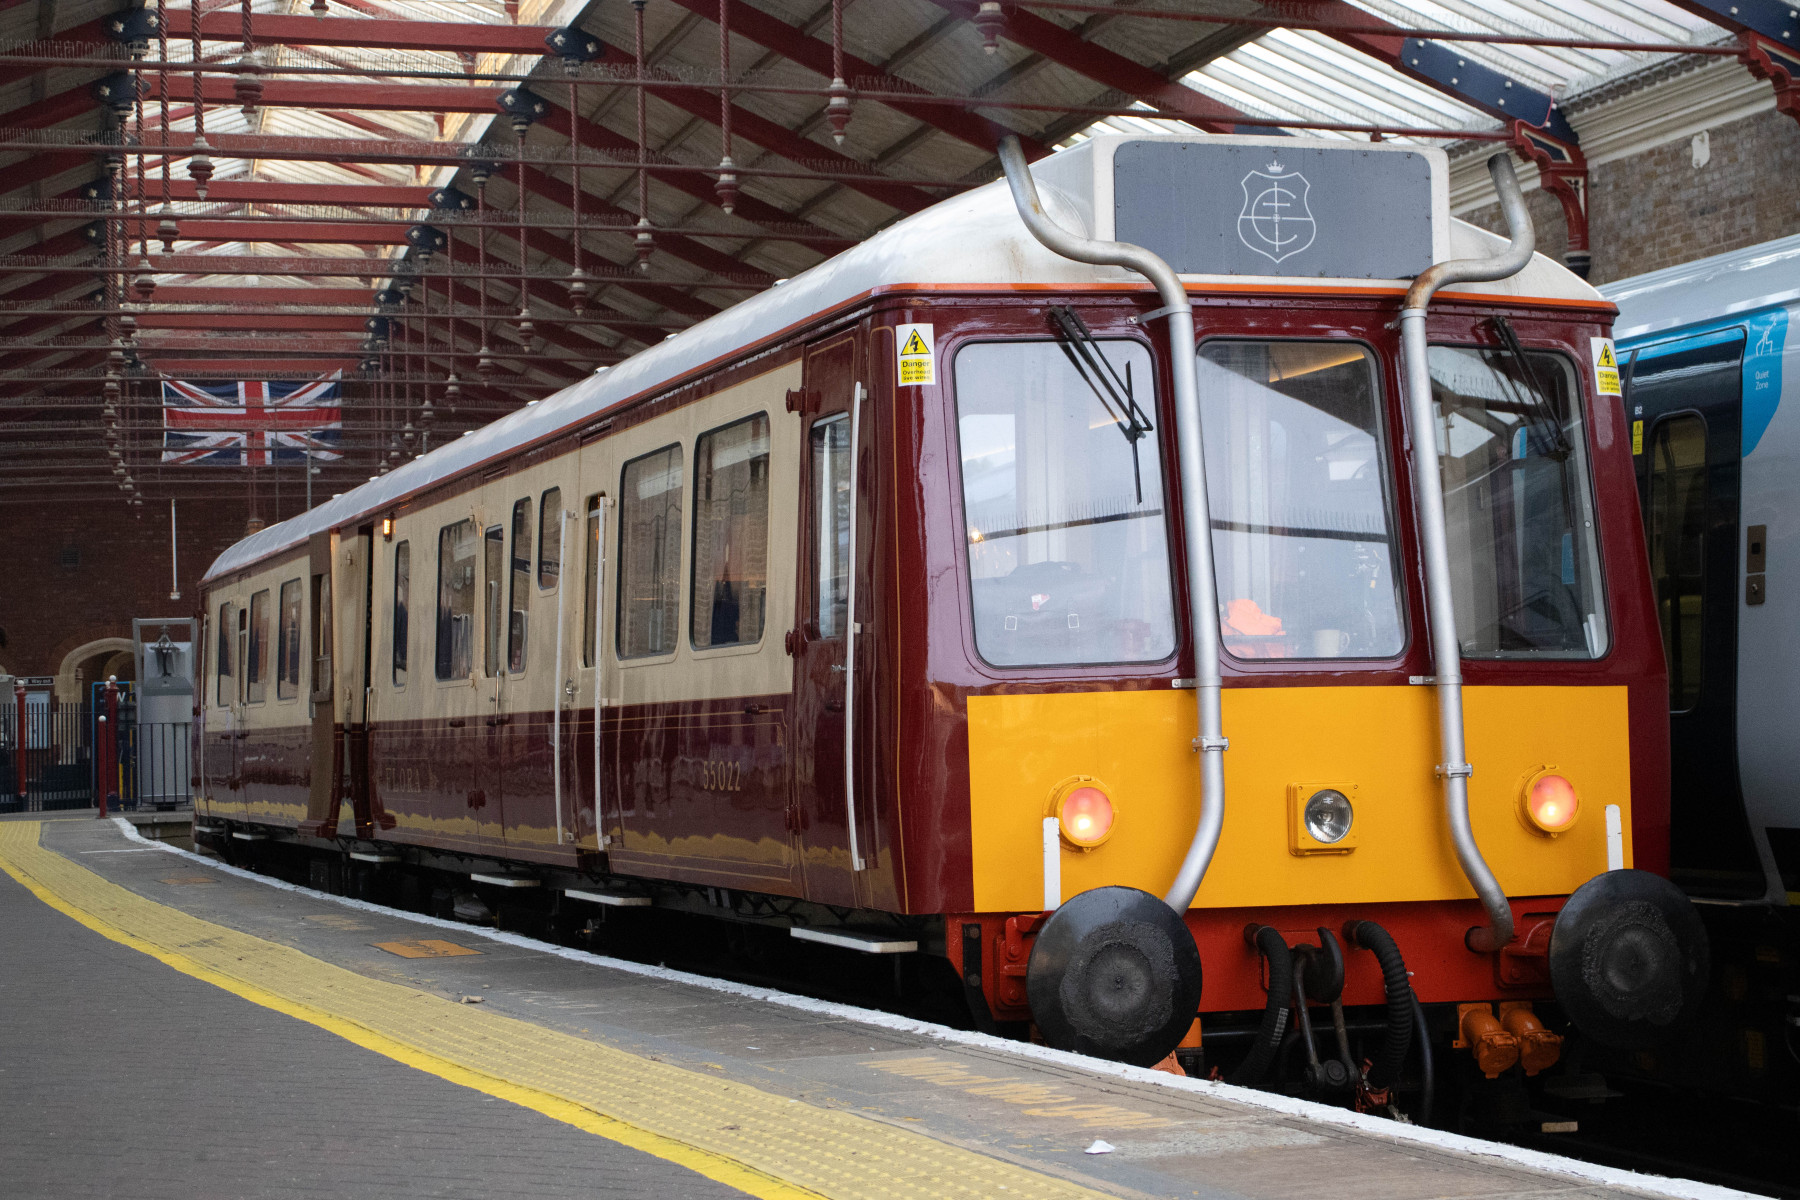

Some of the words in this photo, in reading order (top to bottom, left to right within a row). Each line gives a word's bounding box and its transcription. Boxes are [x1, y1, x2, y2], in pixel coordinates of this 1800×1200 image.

[1755, 370, 1769, 380] Quiet
[1755, 382, 1769, 391] Zone
[385, 767, 421, 792] FLORA
[703, 760, 741, 791] 55022
